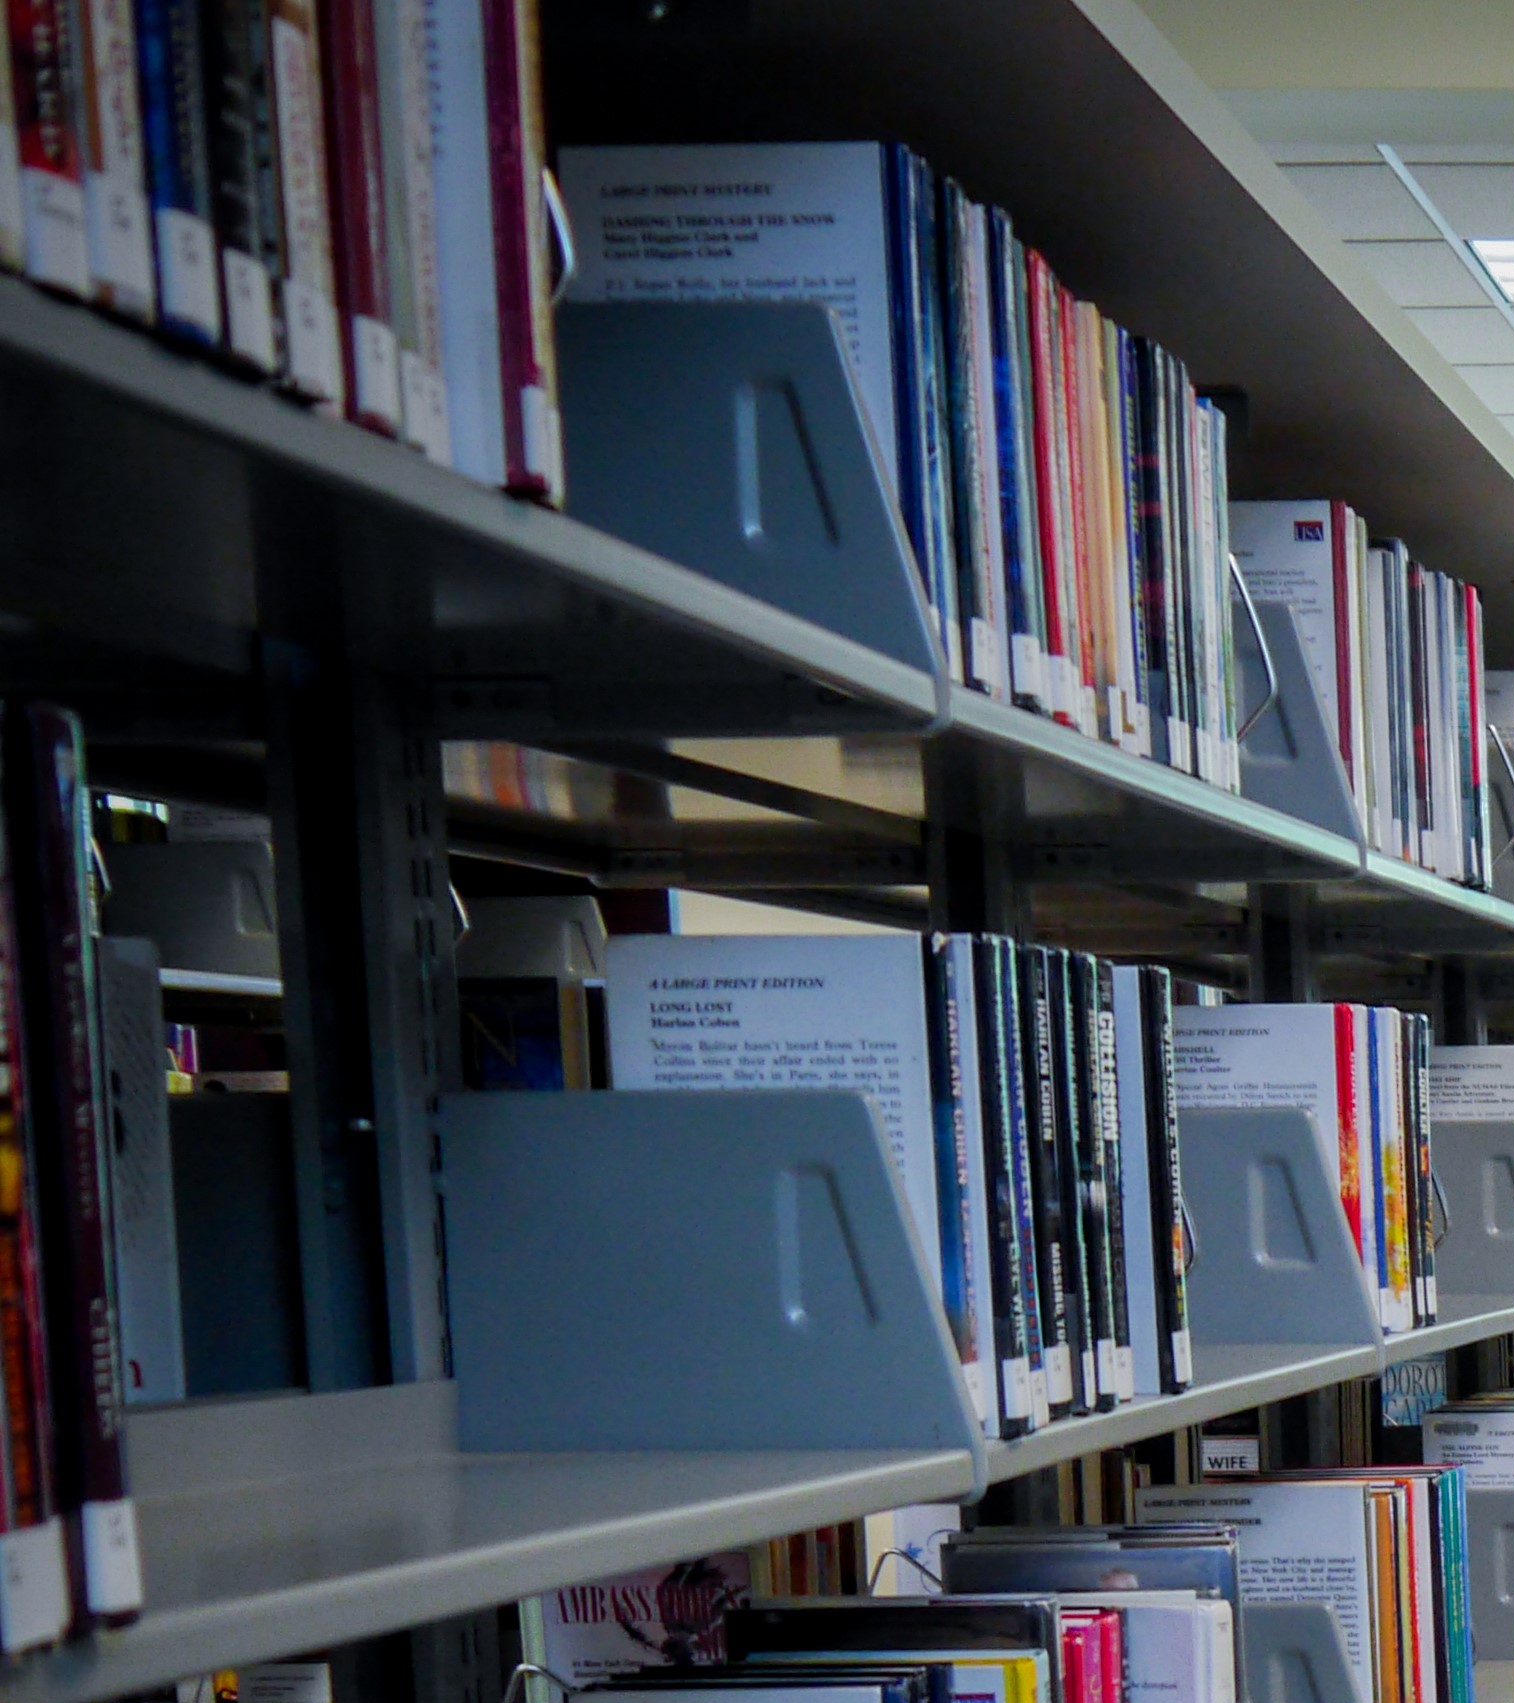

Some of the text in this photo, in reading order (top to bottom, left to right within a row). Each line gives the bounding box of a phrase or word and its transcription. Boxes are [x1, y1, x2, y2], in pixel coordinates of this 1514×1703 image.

[662, 977, 825, 990] LARGE PRINT EDITION
[650, 1002, 733, 1013] LONG LOST
[651, 1017, 741, 1028] Harlan Coben
[1036, 998, 1054, 1143] HARLAN COBEN
[1098, 1010, 1119, 1142] COLLISION
[1207, 1455, 1249, 1470] WIFE
